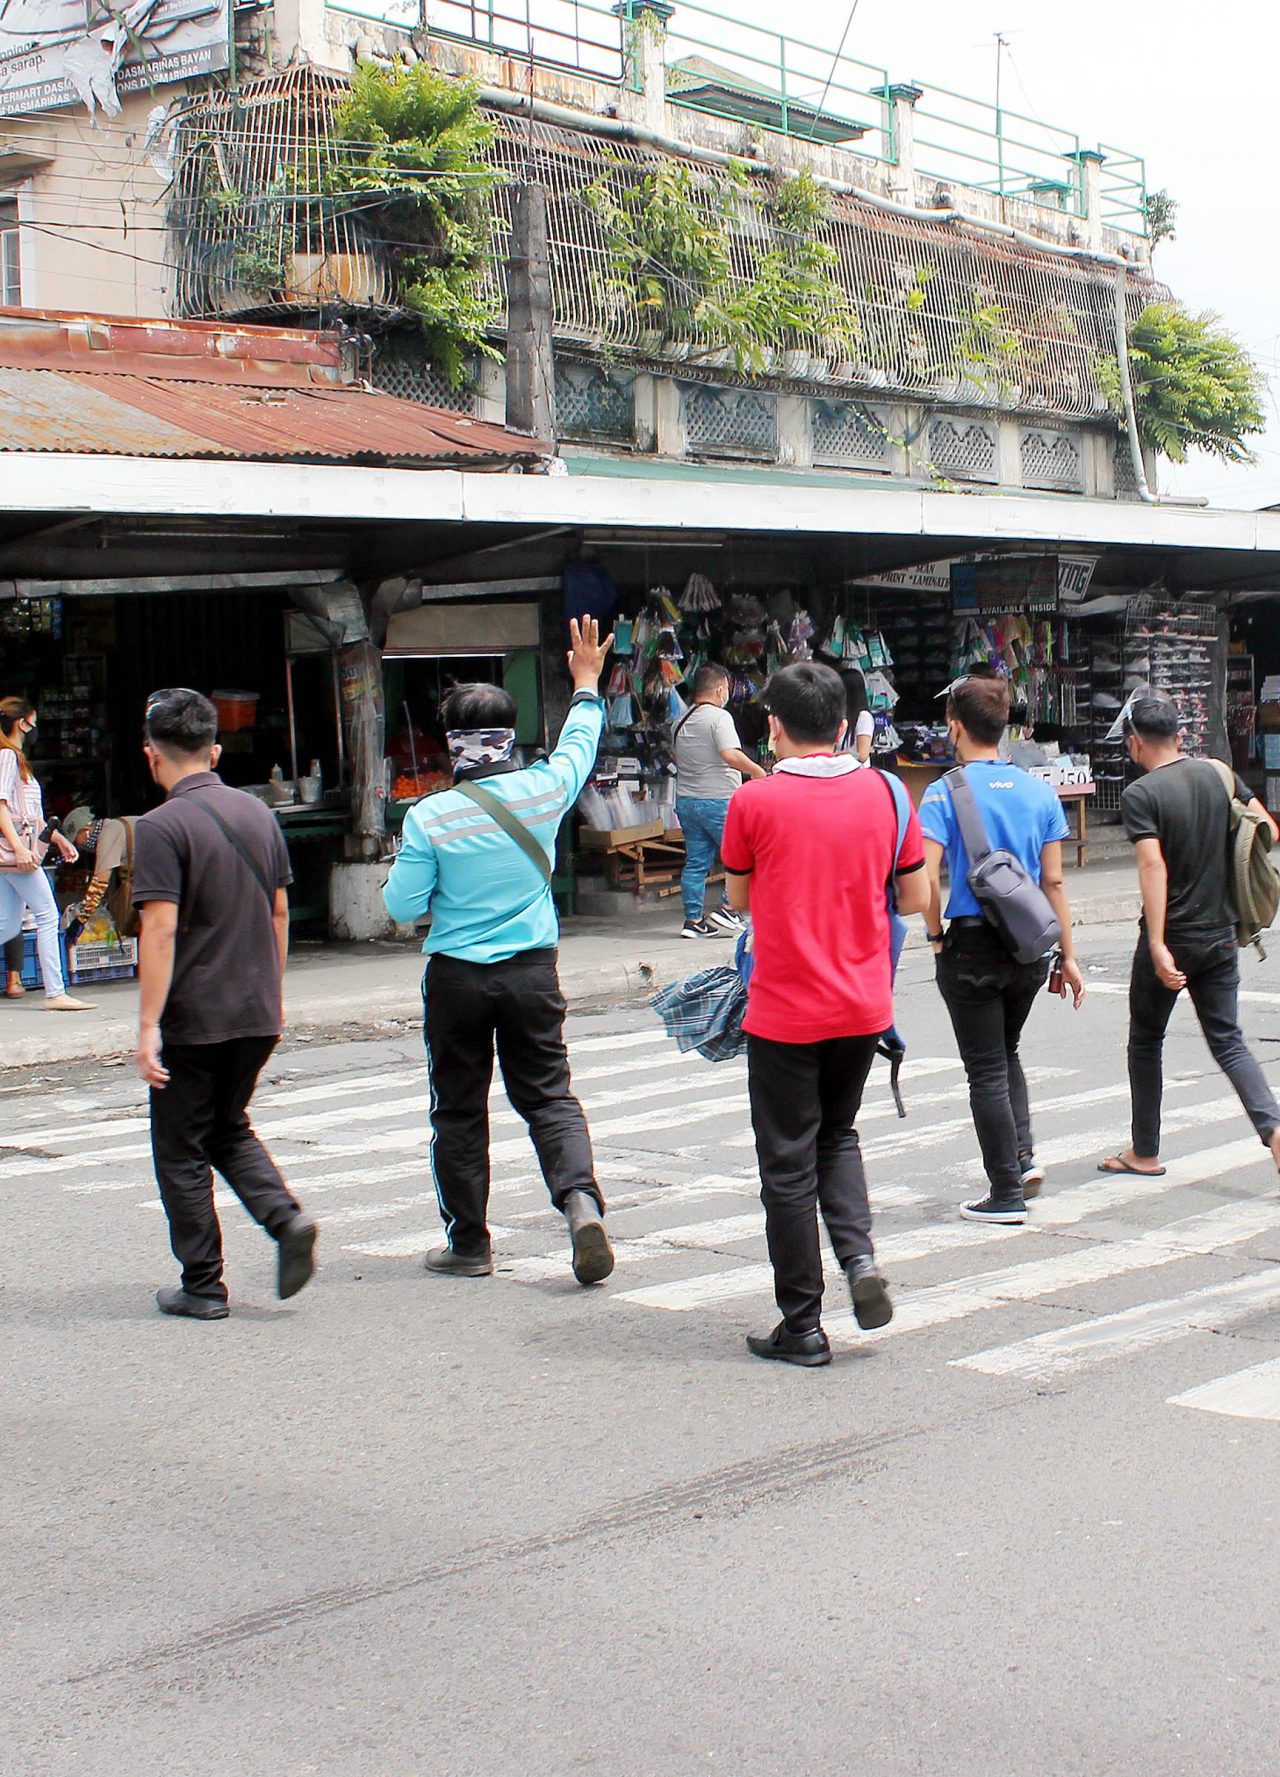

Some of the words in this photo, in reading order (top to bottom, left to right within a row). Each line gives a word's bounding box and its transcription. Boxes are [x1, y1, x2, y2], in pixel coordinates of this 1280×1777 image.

[11, 54, 46, 74] sarap.
[180, 49, 212, 65] BAYAN
[7, 93, 70, 114] DASMARIÑAS
[881, 572, 907, 584] PRINT
[981, 604, 1025, 615] AVAILABLE
[1029, 602, 1057, 612] INSIDE
